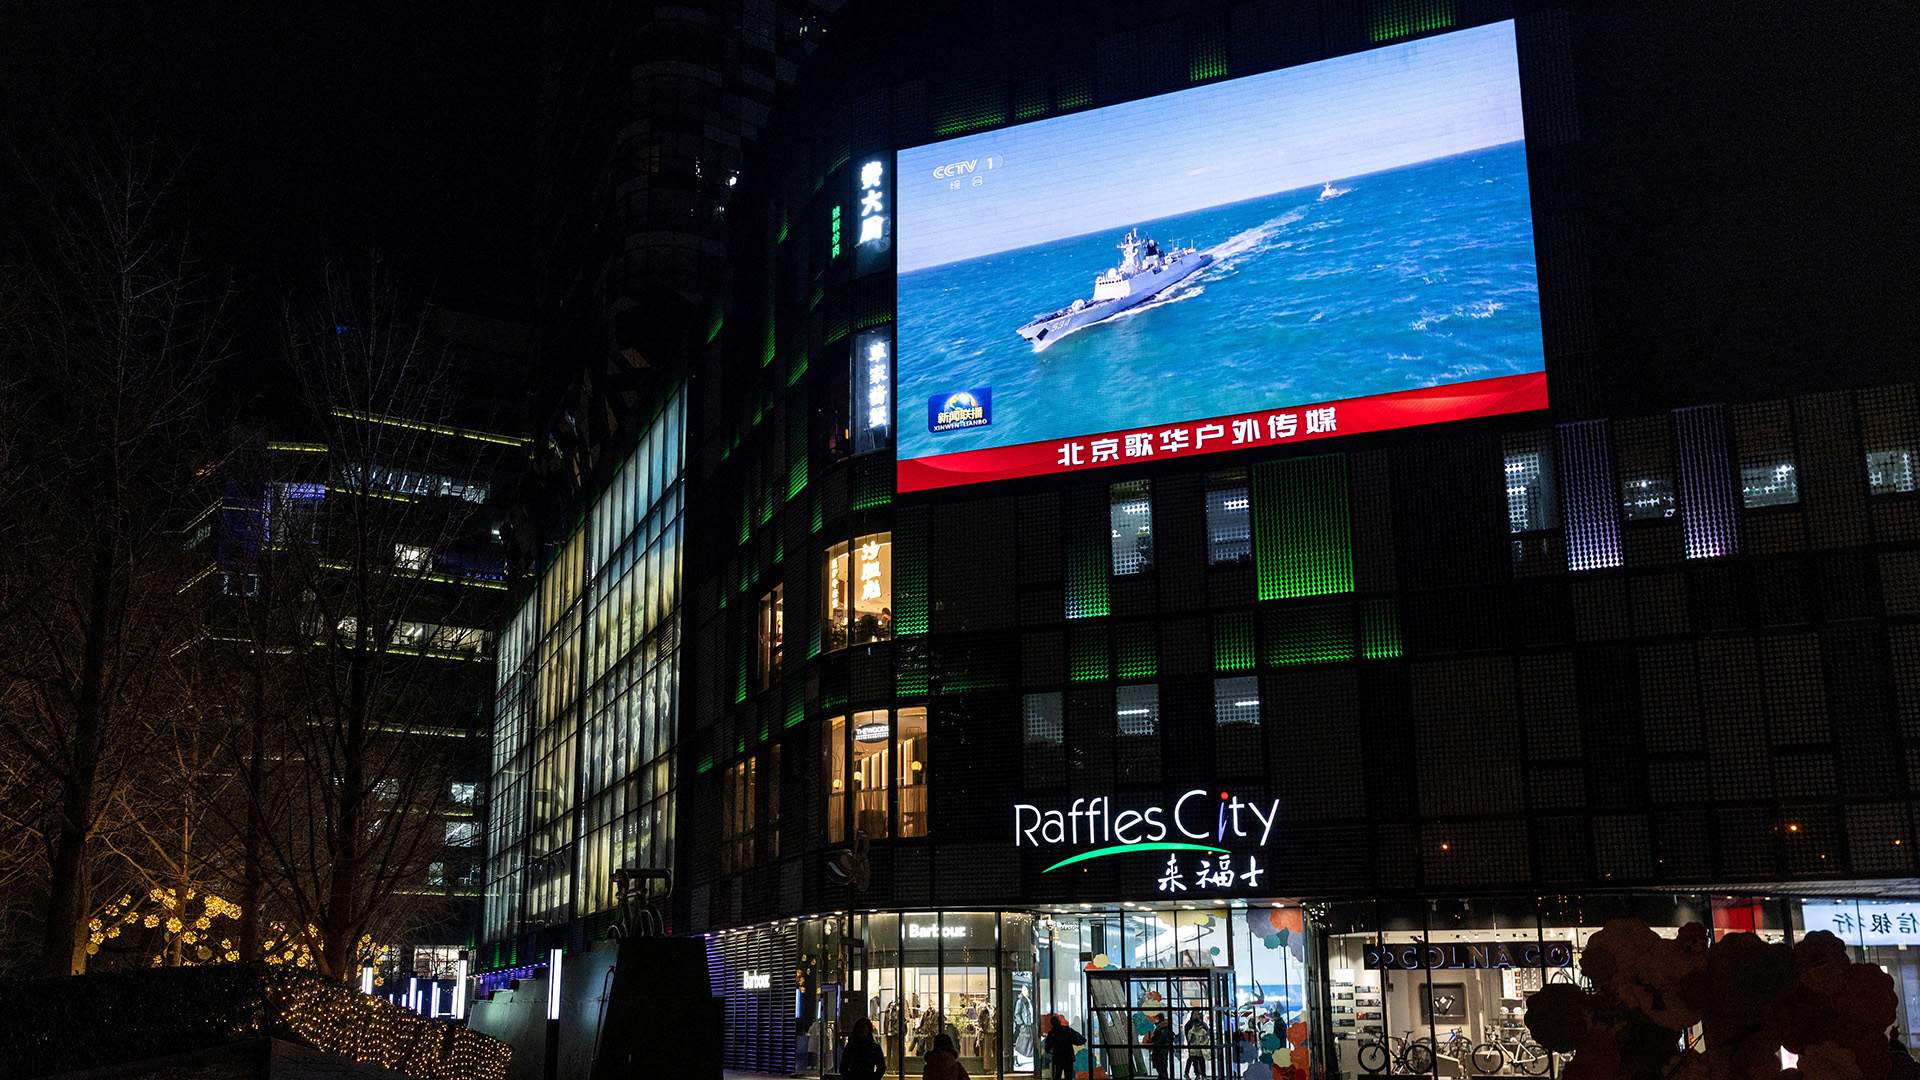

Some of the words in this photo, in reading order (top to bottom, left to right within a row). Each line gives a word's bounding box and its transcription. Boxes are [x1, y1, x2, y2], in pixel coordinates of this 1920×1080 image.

[933, 158, 978, 179] CCTV
[1057, 406, 1338, 467] 北京歌华户外传媒
[1014, 796, 1167, 847] Raffles
[1174, 789, 1280, 847] City
[1158, 852, 1265, 893] 来福士
